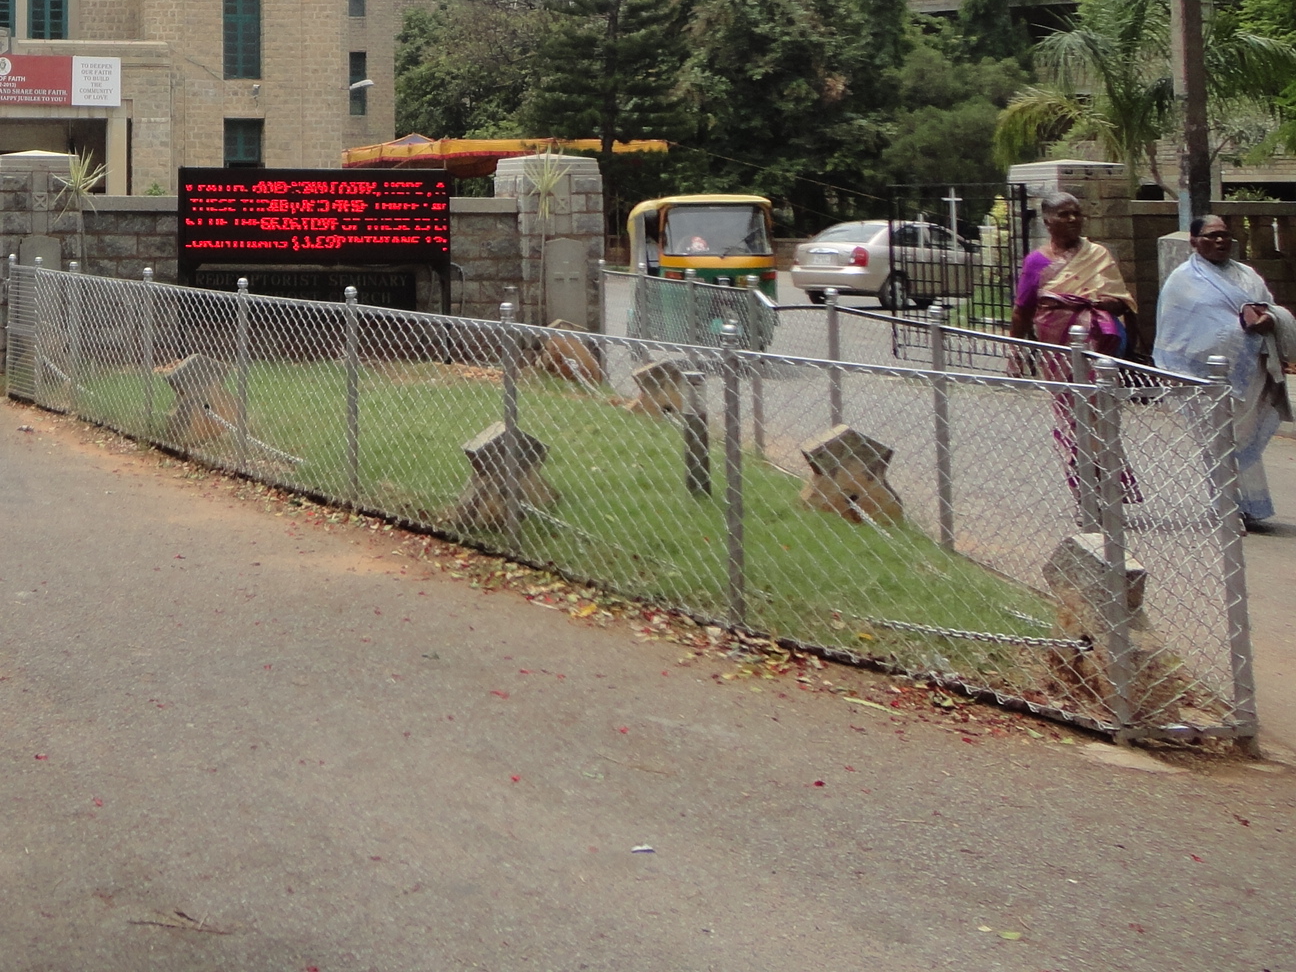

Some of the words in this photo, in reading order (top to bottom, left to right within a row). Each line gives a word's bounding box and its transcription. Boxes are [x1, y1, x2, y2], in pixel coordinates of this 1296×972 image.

[195, 274, 320, 286] REDEPTORIST
[328, 275, 408, 287] SEMINARY
[328, 292, 392, 304] CRCH
